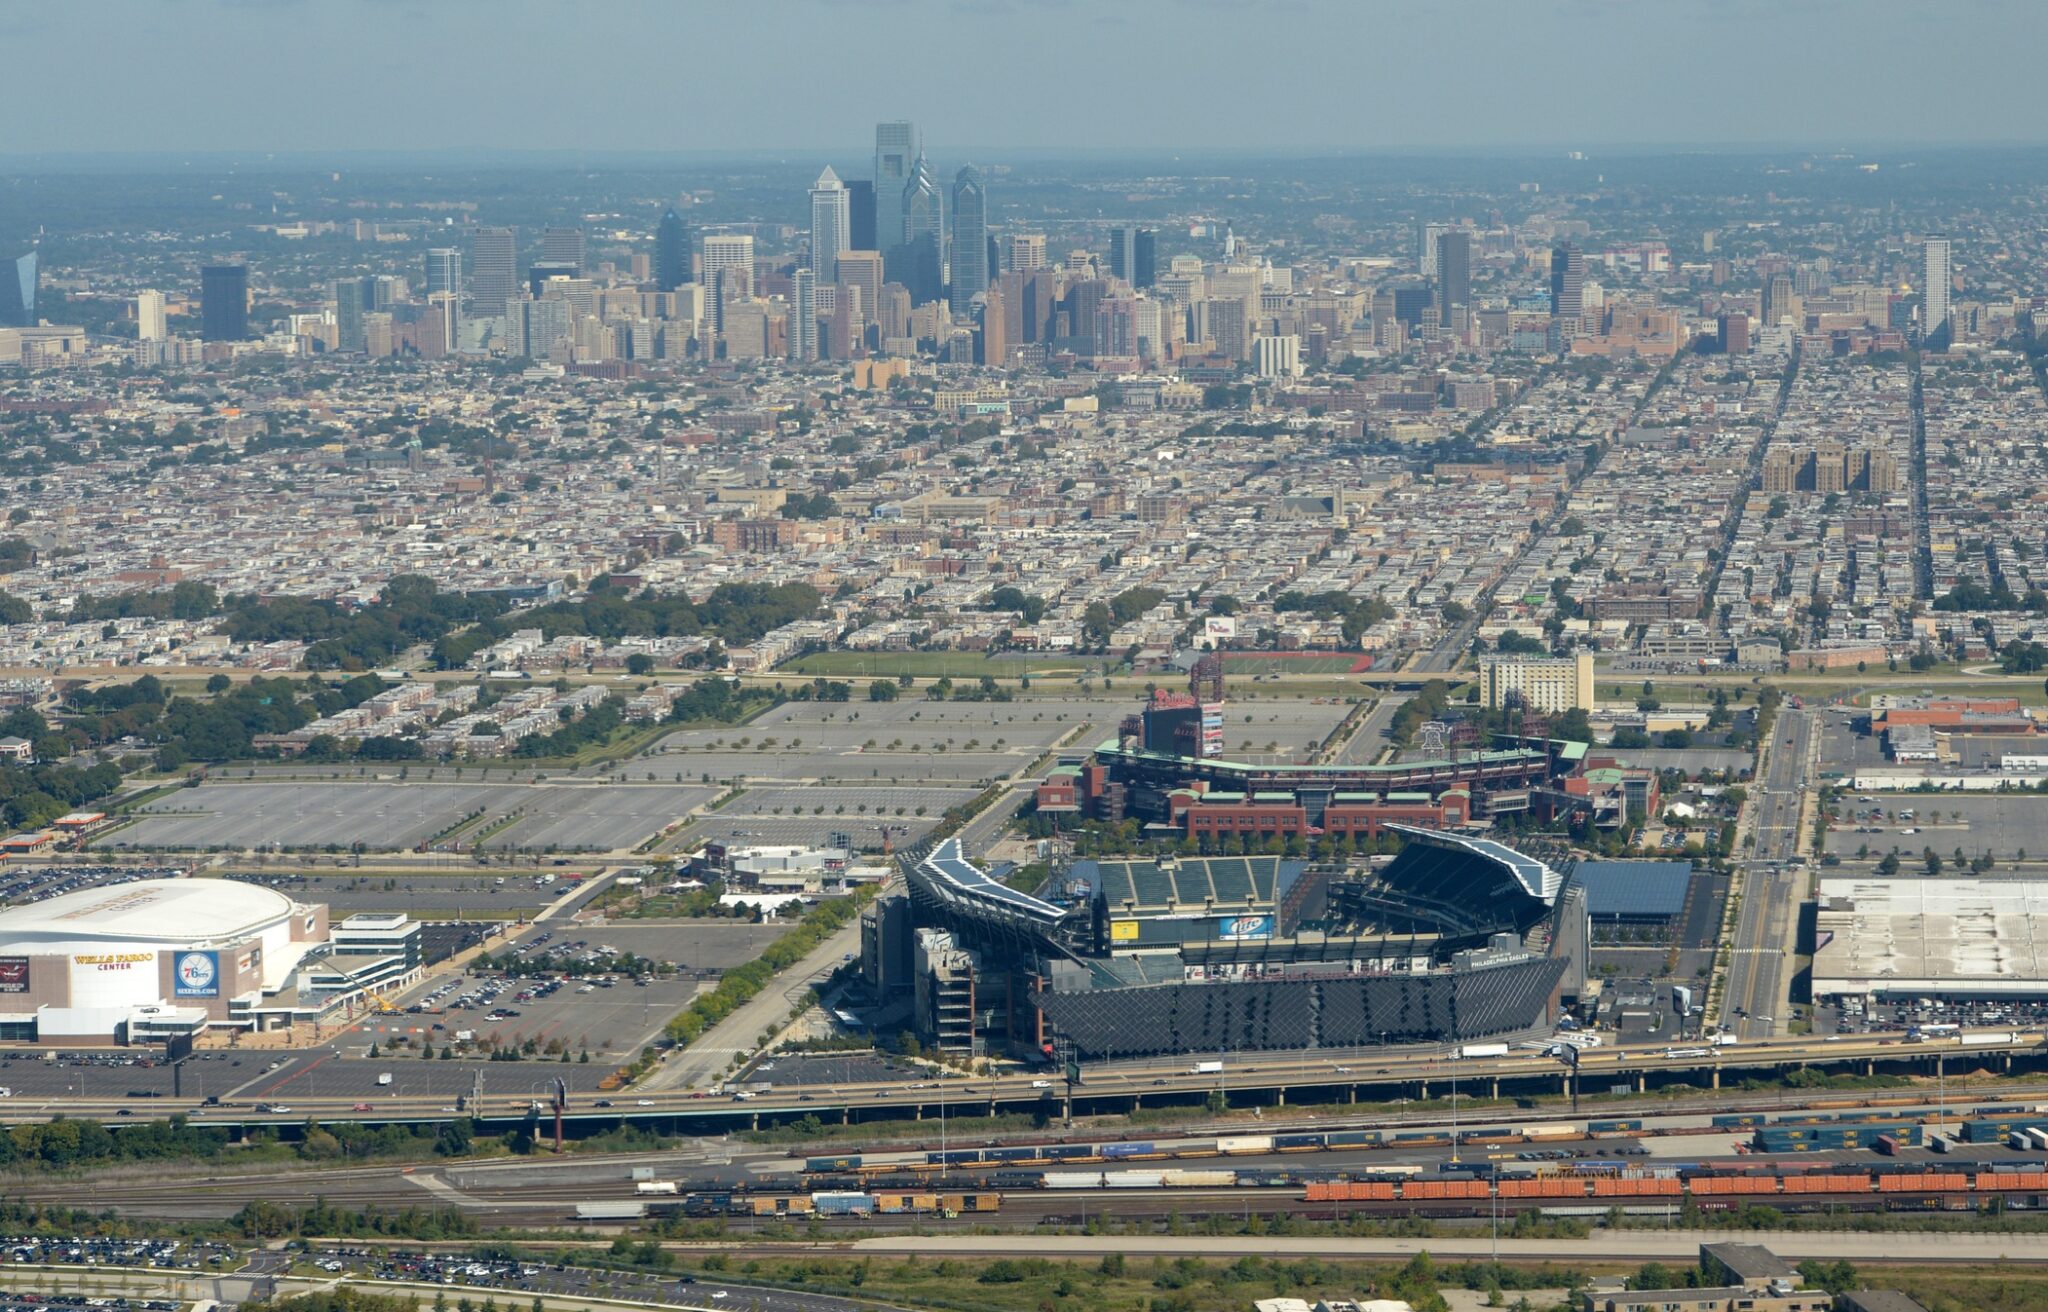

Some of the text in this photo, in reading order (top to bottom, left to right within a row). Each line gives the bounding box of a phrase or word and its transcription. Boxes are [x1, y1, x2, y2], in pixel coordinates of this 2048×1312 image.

[74, 953, 153, 965] WELLS FARGO
[1471, 957, 1509, 968] PHILADELPHIA
[1509, 953, 1529, 962] EAGLES
[97, 963, 131, 971] CENTER
